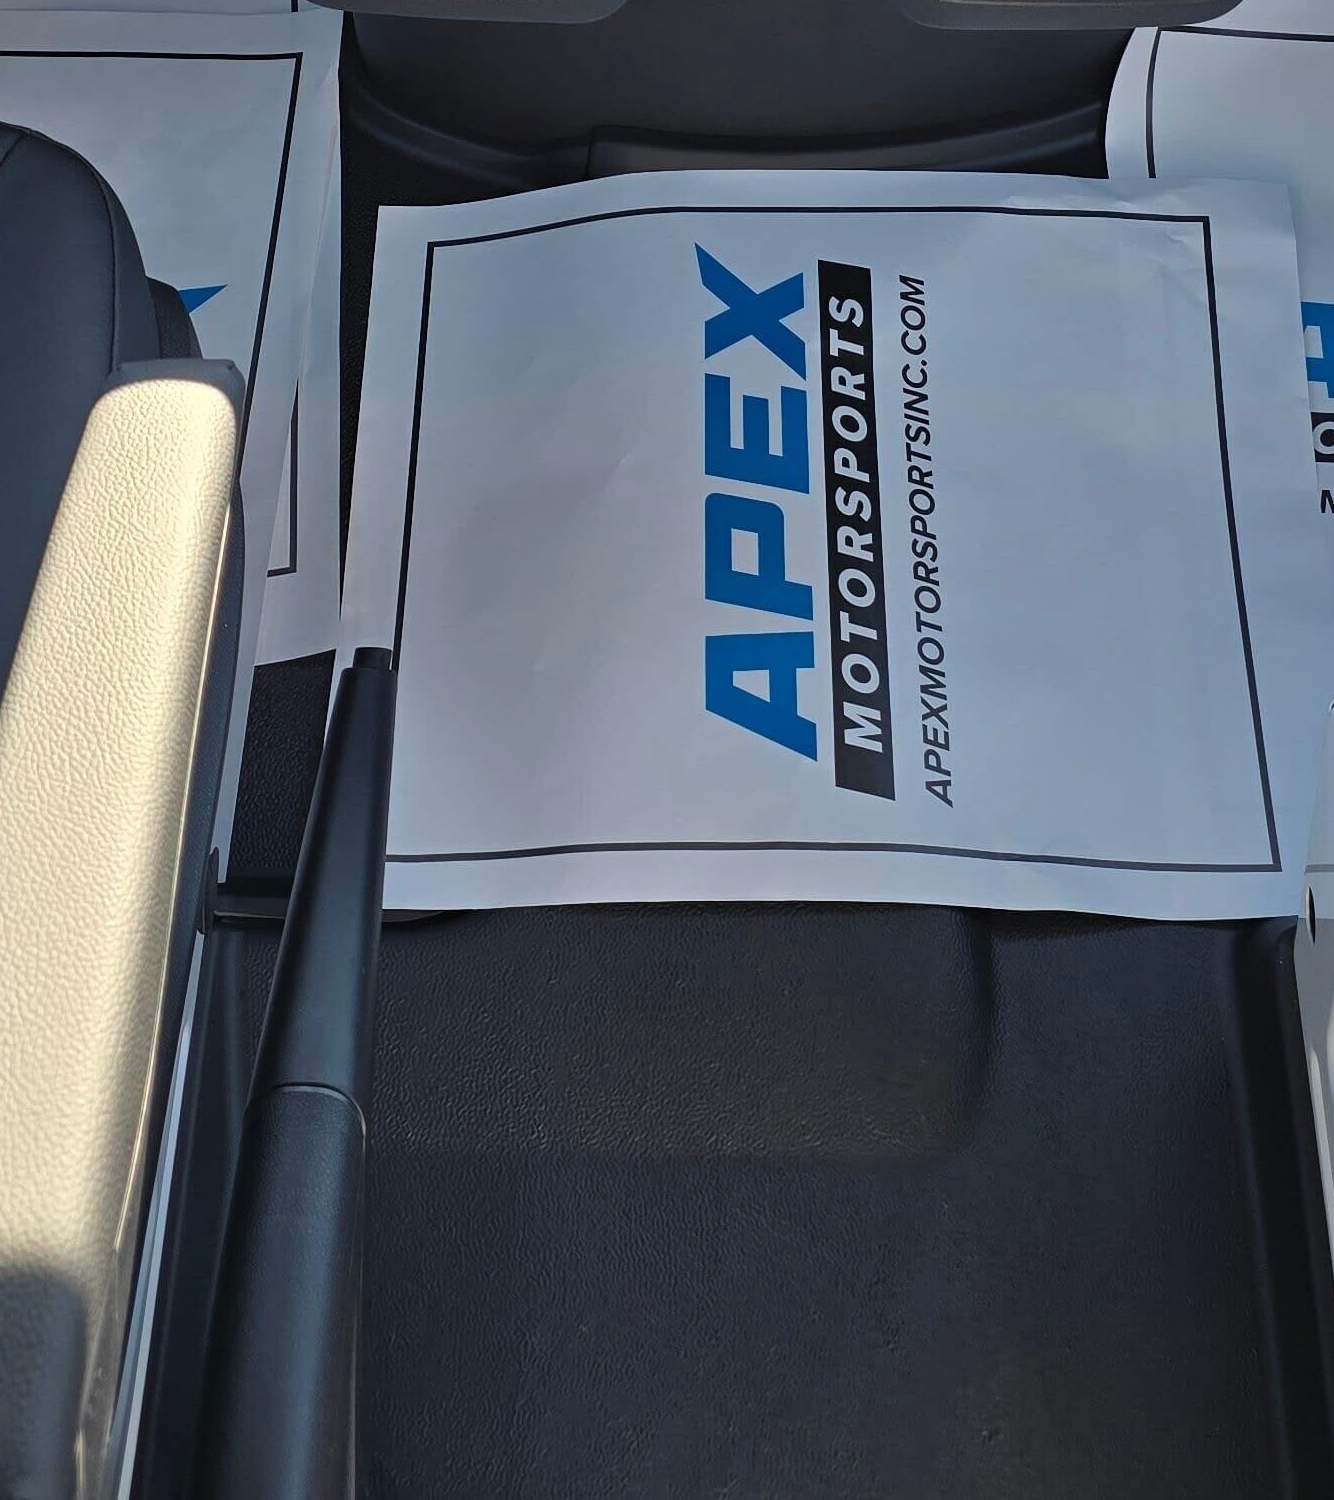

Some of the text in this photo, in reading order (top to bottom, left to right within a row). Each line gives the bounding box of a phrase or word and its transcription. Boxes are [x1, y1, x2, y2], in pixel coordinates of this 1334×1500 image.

[694, 242, 818, 762] APEX
[829, 294, 885, 754] MOTORSPORTS
[898, 274, 955, 809] APEXMOTORSPORTSINC.COM
